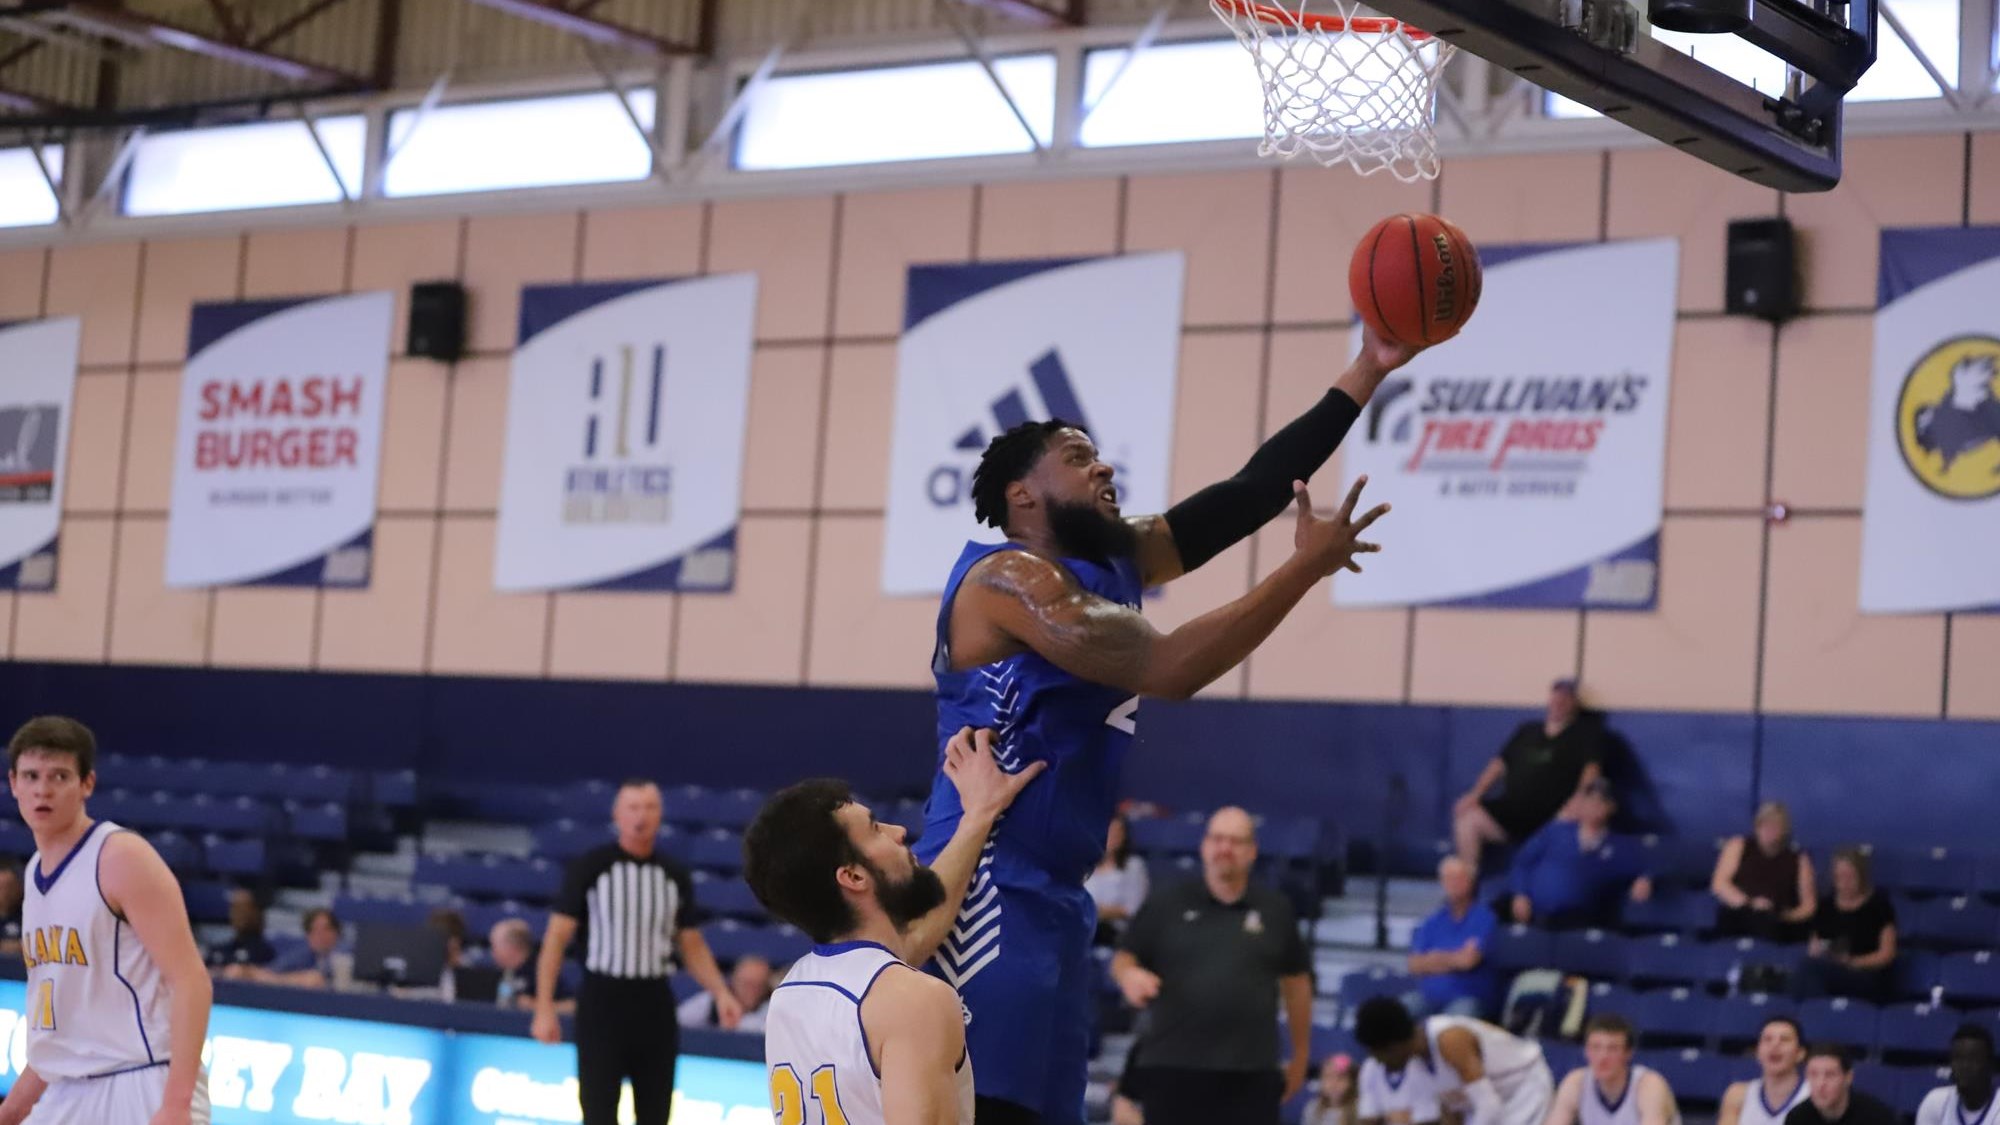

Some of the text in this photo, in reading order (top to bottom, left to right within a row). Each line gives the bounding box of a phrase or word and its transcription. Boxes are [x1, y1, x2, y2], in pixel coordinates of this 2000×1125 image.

[1433, 234, 1456, 322] Wilson
[199, 376, 364, 420] SMASH
[1420, 374, 1647, 413] SULLIVAN'S
[194, 428, 359, 471] BURGER
[1405, 417, 1605, 472] TIRE PROS
[771, 1062, 851, 1125] 21
